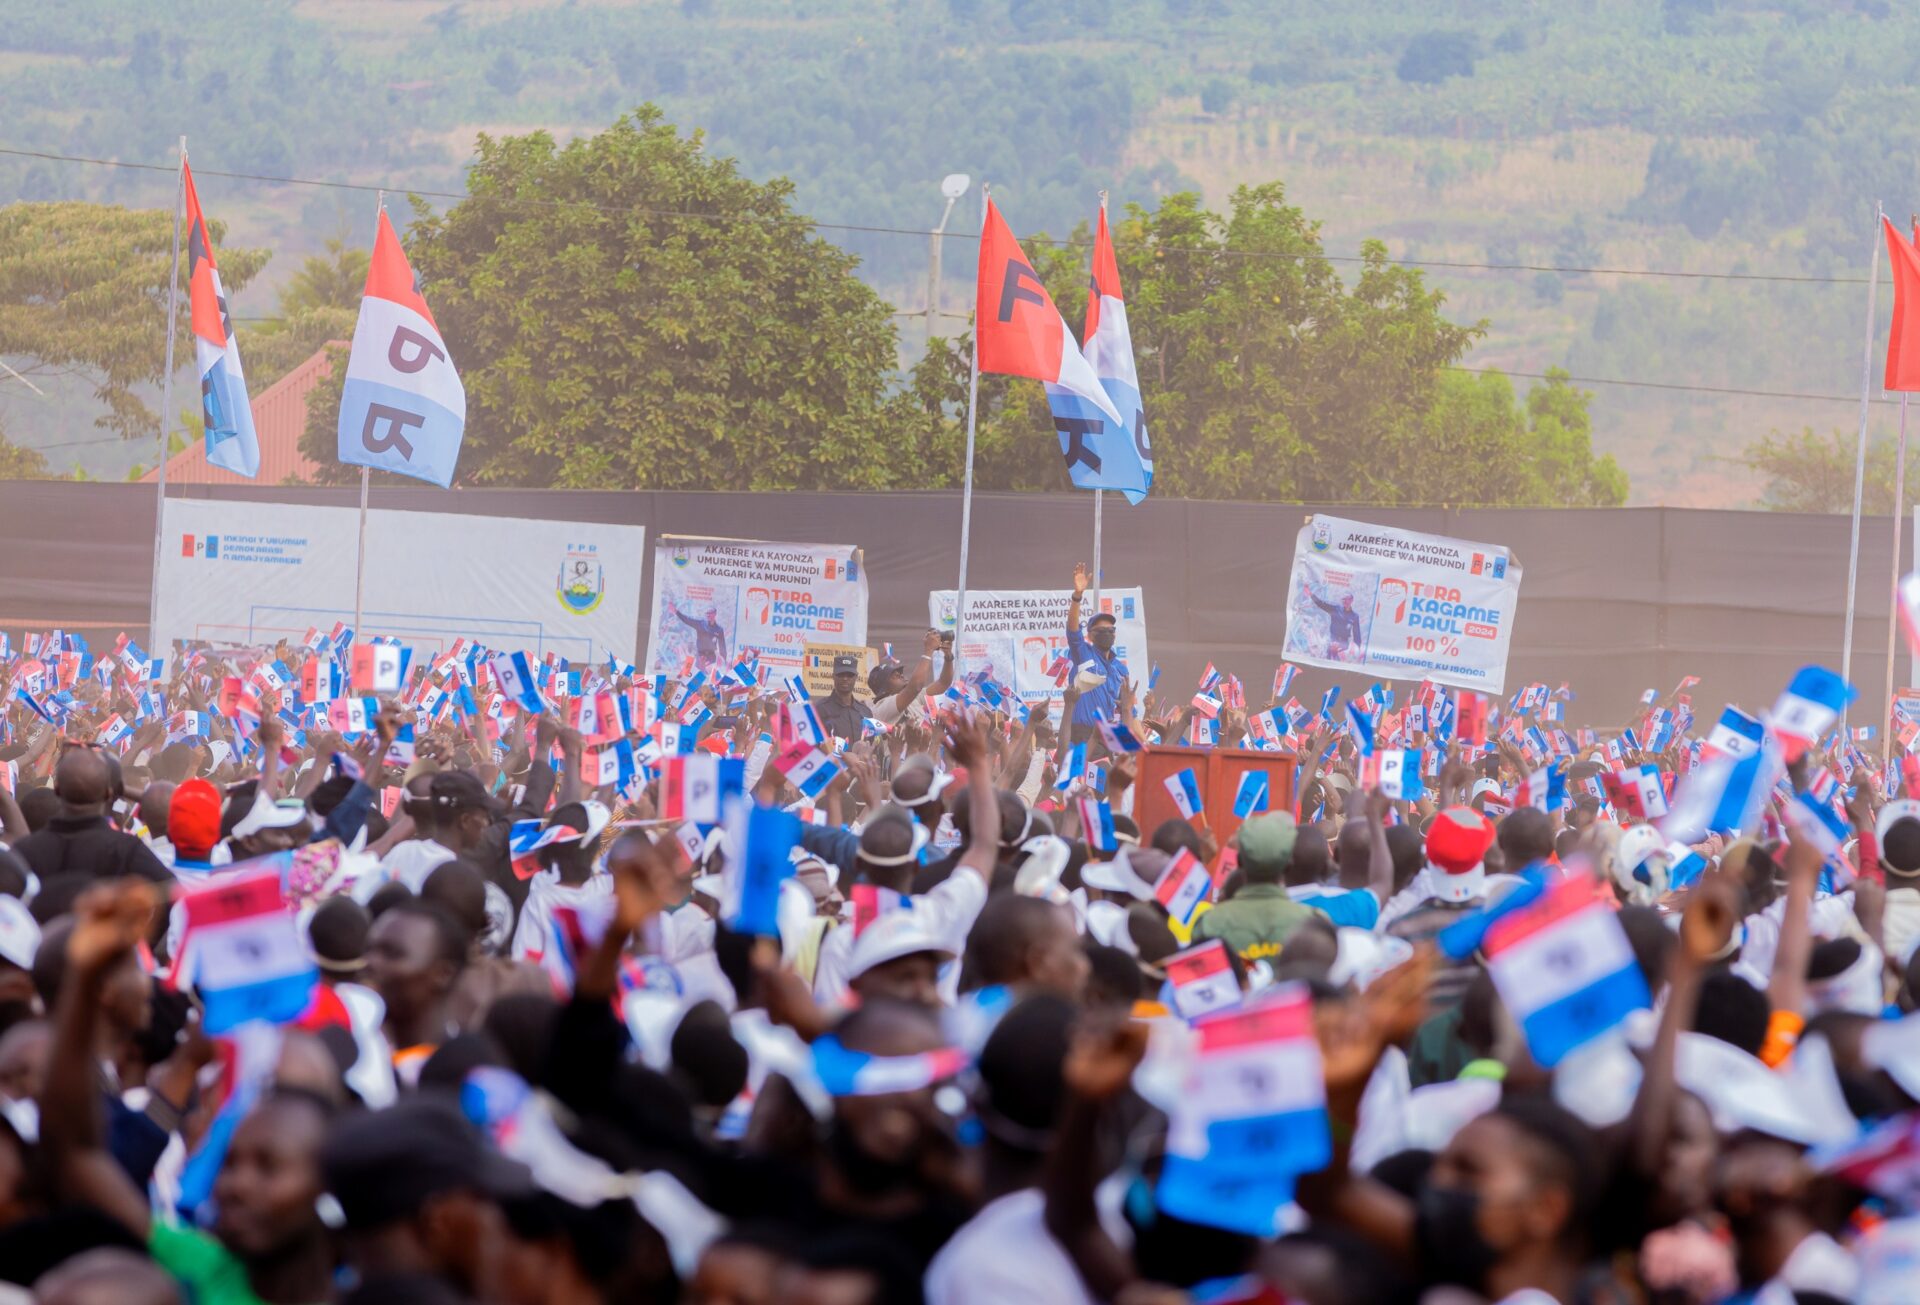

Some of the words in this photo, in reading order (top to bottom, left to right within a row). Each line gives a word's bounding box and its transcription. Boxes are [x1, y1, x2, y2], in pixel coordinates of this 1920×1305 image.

[998, 258, 1044, 322] F
[1348, 534, 1394, 547] AKARERE
[1396, 540, 1410, 549] KA
[1412, 543, 1459, 558] KAYONZA
[705, 546, 749, 558] AKARERE
[752, 550, 764, 559] KA
[768, 552, 813, 563] KAYONZA
[1338, 542, 1396, 558] UMURENGE
[1398, 552, 1415, 562] WA
[1417, 555, 1465, 570] MURUNDI
[697, 556, 752, 569] UMURENGE
[754, 562, 770, 570] WA
[773, 564, 819, 575] MURUNDI
[704, 567, 746, 578] AKAGARI
[750, 572, 762, 580] KA
[764, 574, 811, 585] MURUNDI
[972, 600, 1022, 609] AKARERE
[1024, 600, 1037, 608] KA
[1040, 598, 1088, 608] KAYONA
[774, 602, 844, 619] KAGAME
[964, 611, 1024, 621] UMURENGE
[1027, 610, 1045, 618] WA
[1047, 608, 1094, 618] MURND
[1412, 597, 1500, 624] KAGAME
[772, 615, 816, 630] PAUL
[964, 622, 1010, 632] AKAGARI
[1012, 622, 1027, 630] KA
[1408, 613, 1462, 634] PAUL
[1468, 625, 1494, 636] 2024
[774, 633, 792, 643] 100
[1406, 636, 1436, 652] 100
[1440, 636, 1459, 657] %
[379, 661, 394, 676] P
[306, 678, 315, 689] F
[502, 670, 513, 684] P
[558, 680, 565, 689] P
[284, 697, 292, 706] P
[492, 701, 500, 710] P
[352, 710, 362, 722] P
[582, 709, 592, 721] P
[606, 713, 614, 728] F
[1414, 713, 1422, 723] P
[188, 719, 196, 728] P
[1202, 727, 1208, 736] P
[665, 736, 675, 748] P
[1726, 738, 1741, 753] P
[390, 746, 402, 757] P
[788, 749, 802, 759] F
[801, 760, 814, 771] P
[1385, 760, 1398, 772] P
[604, 761, 614, 774] P
[1646, 790, 1658, 804] P
[688, 838, 698, 852] P
[1221, 862, 1231, 874] F
